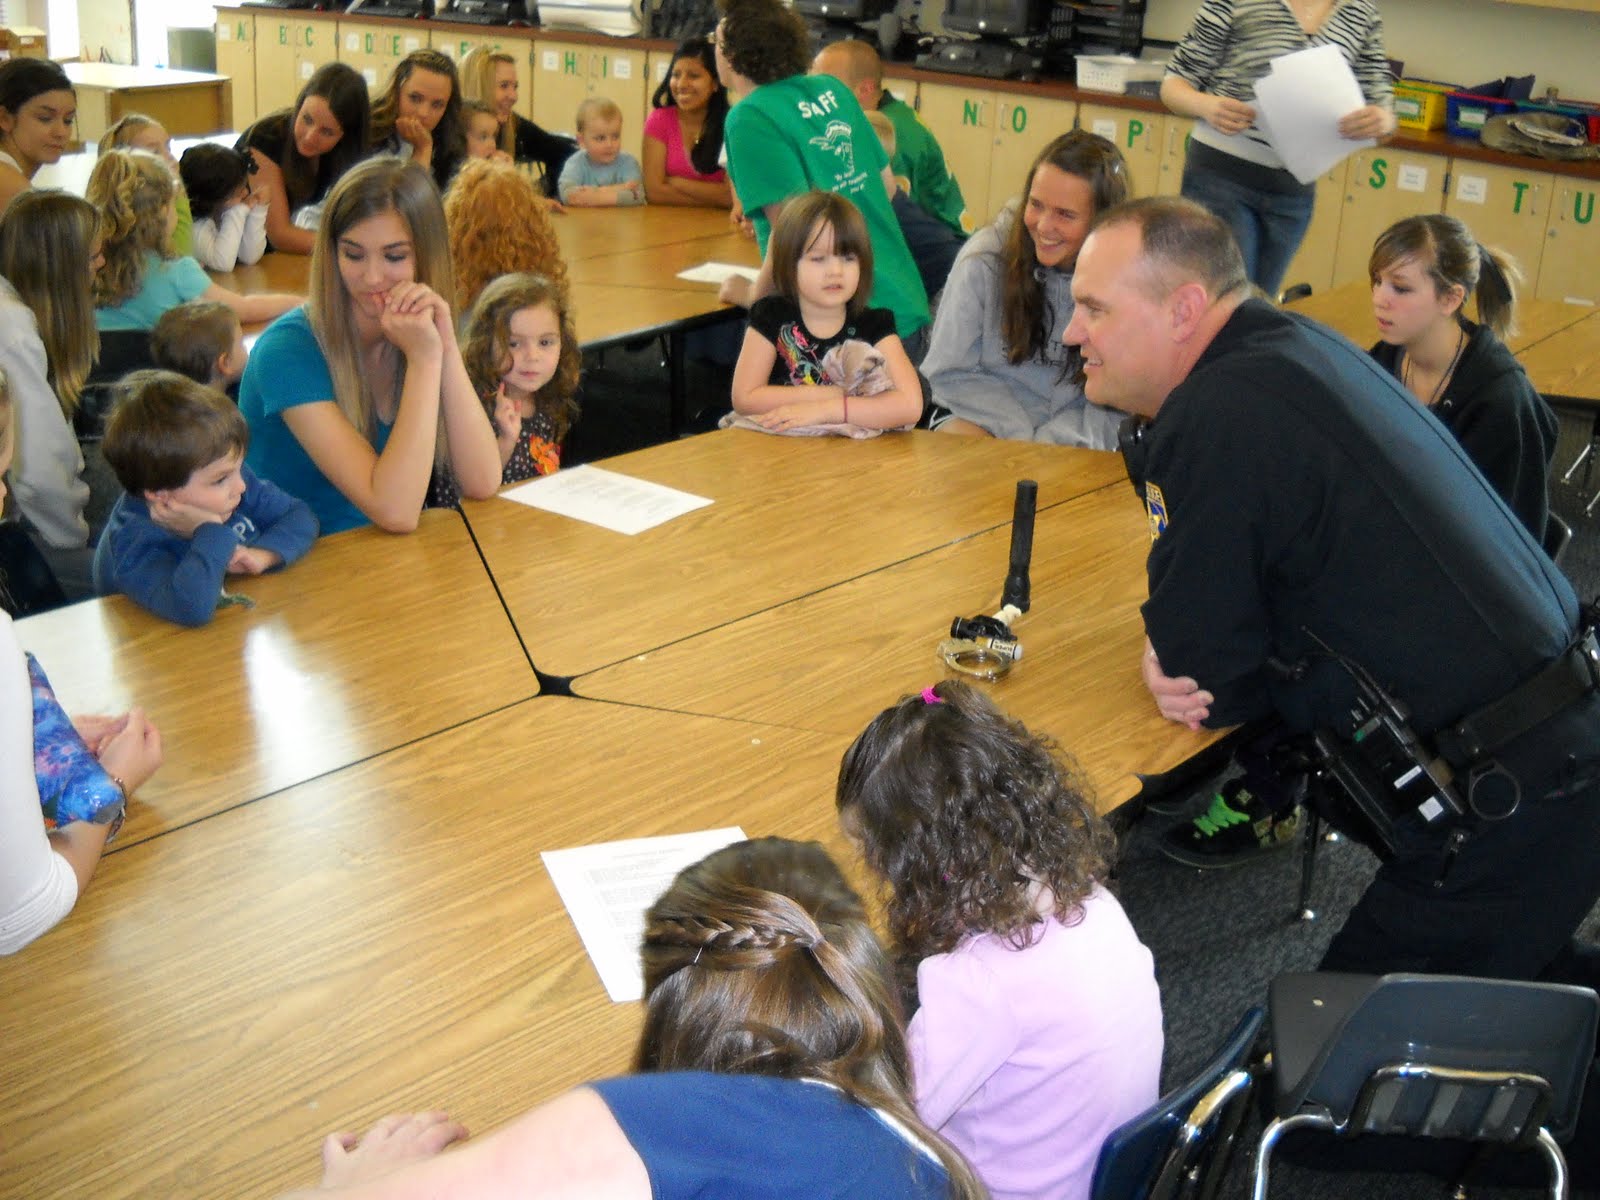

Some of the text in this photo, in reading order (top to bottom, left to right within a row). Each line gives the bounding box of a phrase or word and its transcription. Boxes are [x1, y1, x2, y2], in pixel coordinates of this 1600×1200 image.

[236, 21, 246, 41] A
[279, 25, 287, 45] B
[305, 26, 314, 46] C
[365, 33, 374, 53] D
[392, 35, 401, 56] E
[564, 53, 577, 75] H
[602, 55, 608, 78] I
[798, 90, 838, 118] SAFF
[963, 100, 978, 126] N
[1012, 105, 1027, 133] O
[1128, 119, 1144, 147] P
[1369, 159, 1387, 189] S
[1513, 182, 1529, 214] T
[1574, 192, 1595, 224] U
